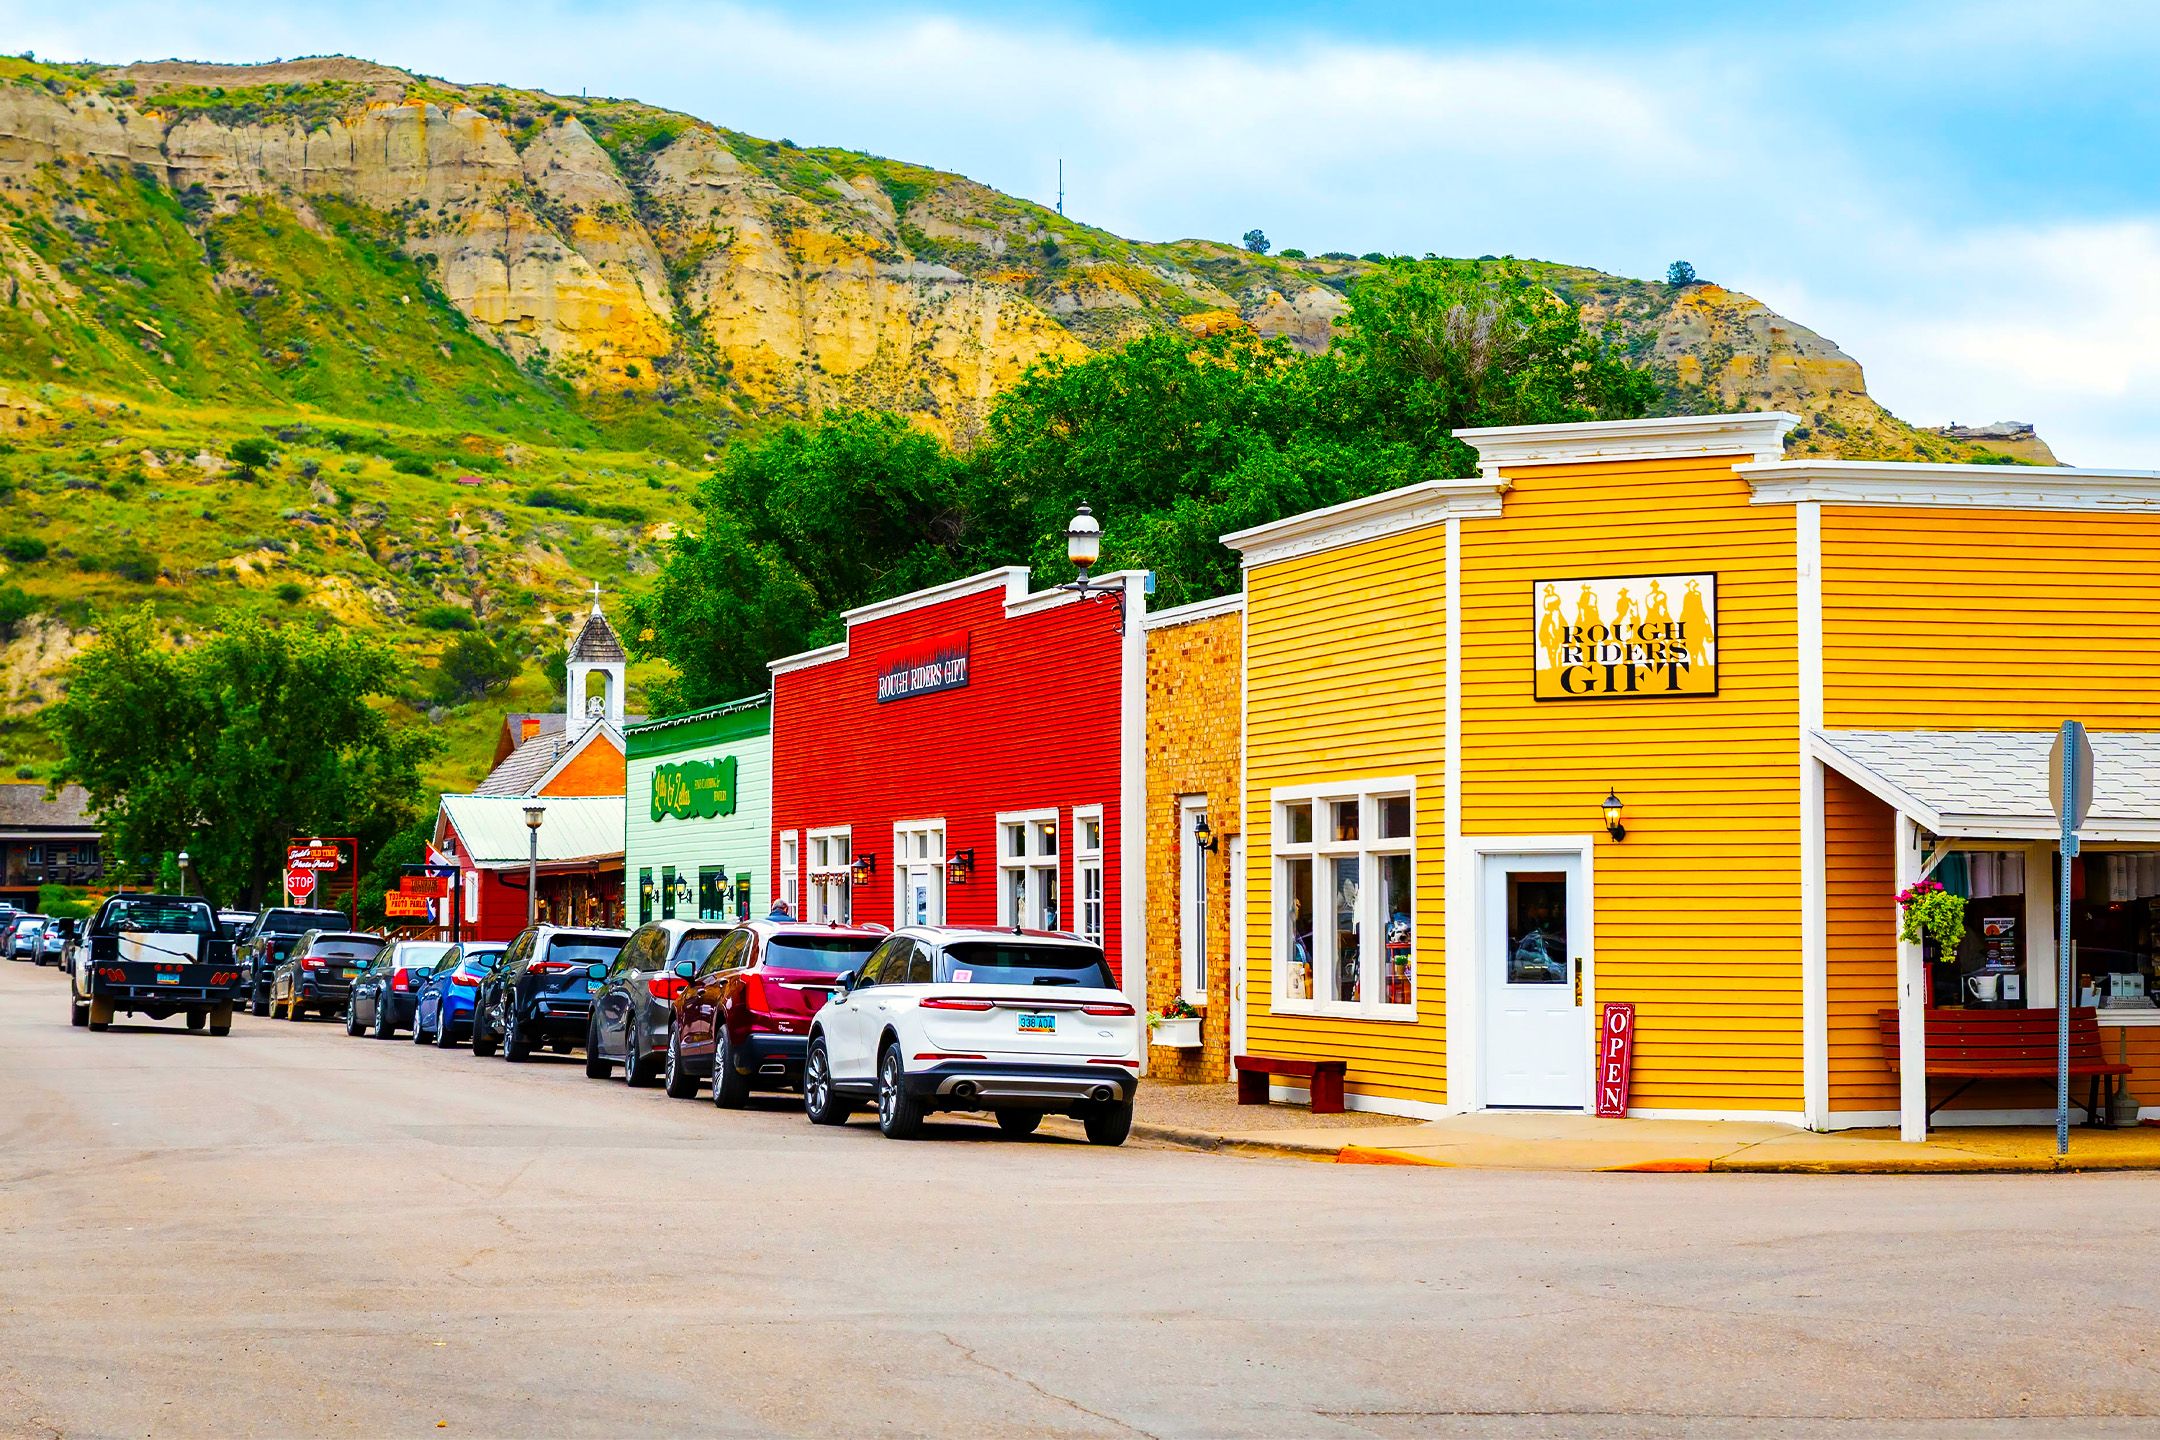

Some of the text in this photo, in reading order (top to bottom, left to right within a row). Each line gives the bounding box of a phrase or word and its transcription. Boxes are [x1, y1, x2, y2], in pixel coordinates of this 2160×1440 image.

[1563, 621, 1686, 644] ROUGH
[1563, 641, 1688, 664] RIDERS
[878, 657, 966, 699] ROUGH RIDERS GIFT
[1560, 661, 1690, 694] GIFT
[310, 849, 321, 857] OLD
[322, 849, 336, 857] TIME
[291, 860, 312, 868] Photo
[288, 877, 313, 887] STOP
[391, 900, 408, 908] PHOTO
[1020, 1018, 1035, 1027] 338
[1604, 1012, 1627, 1108] OPEN
